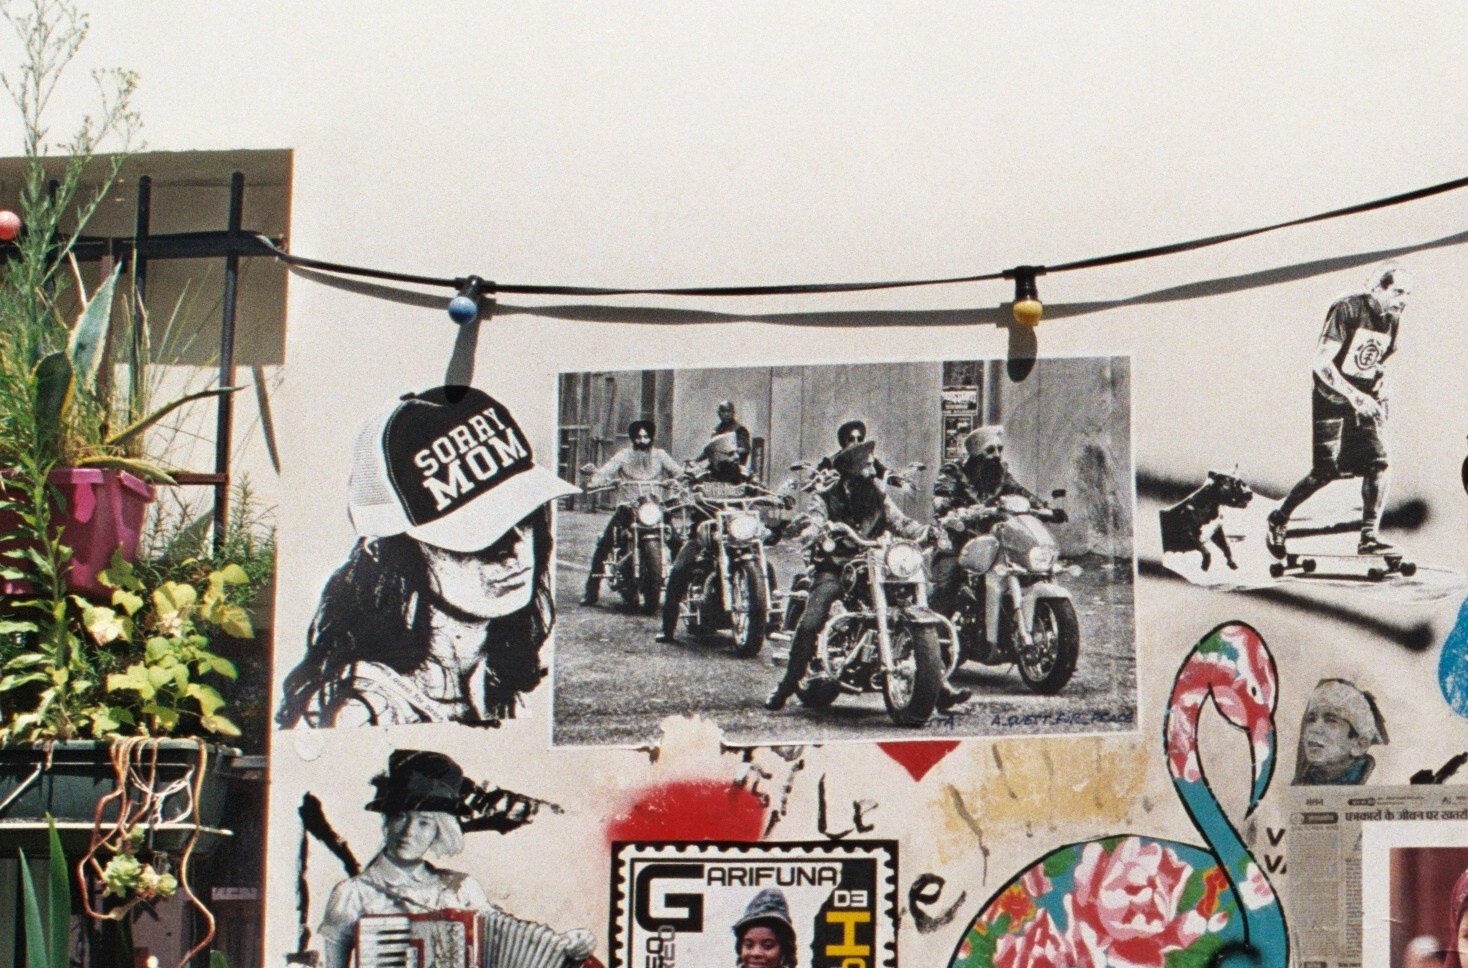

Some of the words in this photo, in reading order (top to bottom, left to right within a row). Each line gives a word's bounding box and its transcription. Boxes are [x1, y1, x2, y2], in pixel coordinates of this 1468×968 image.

[414, 407, 505, 476] SORRY
[422, 427, 528, 511] MOM
[834, 889, 869, 907] DE
